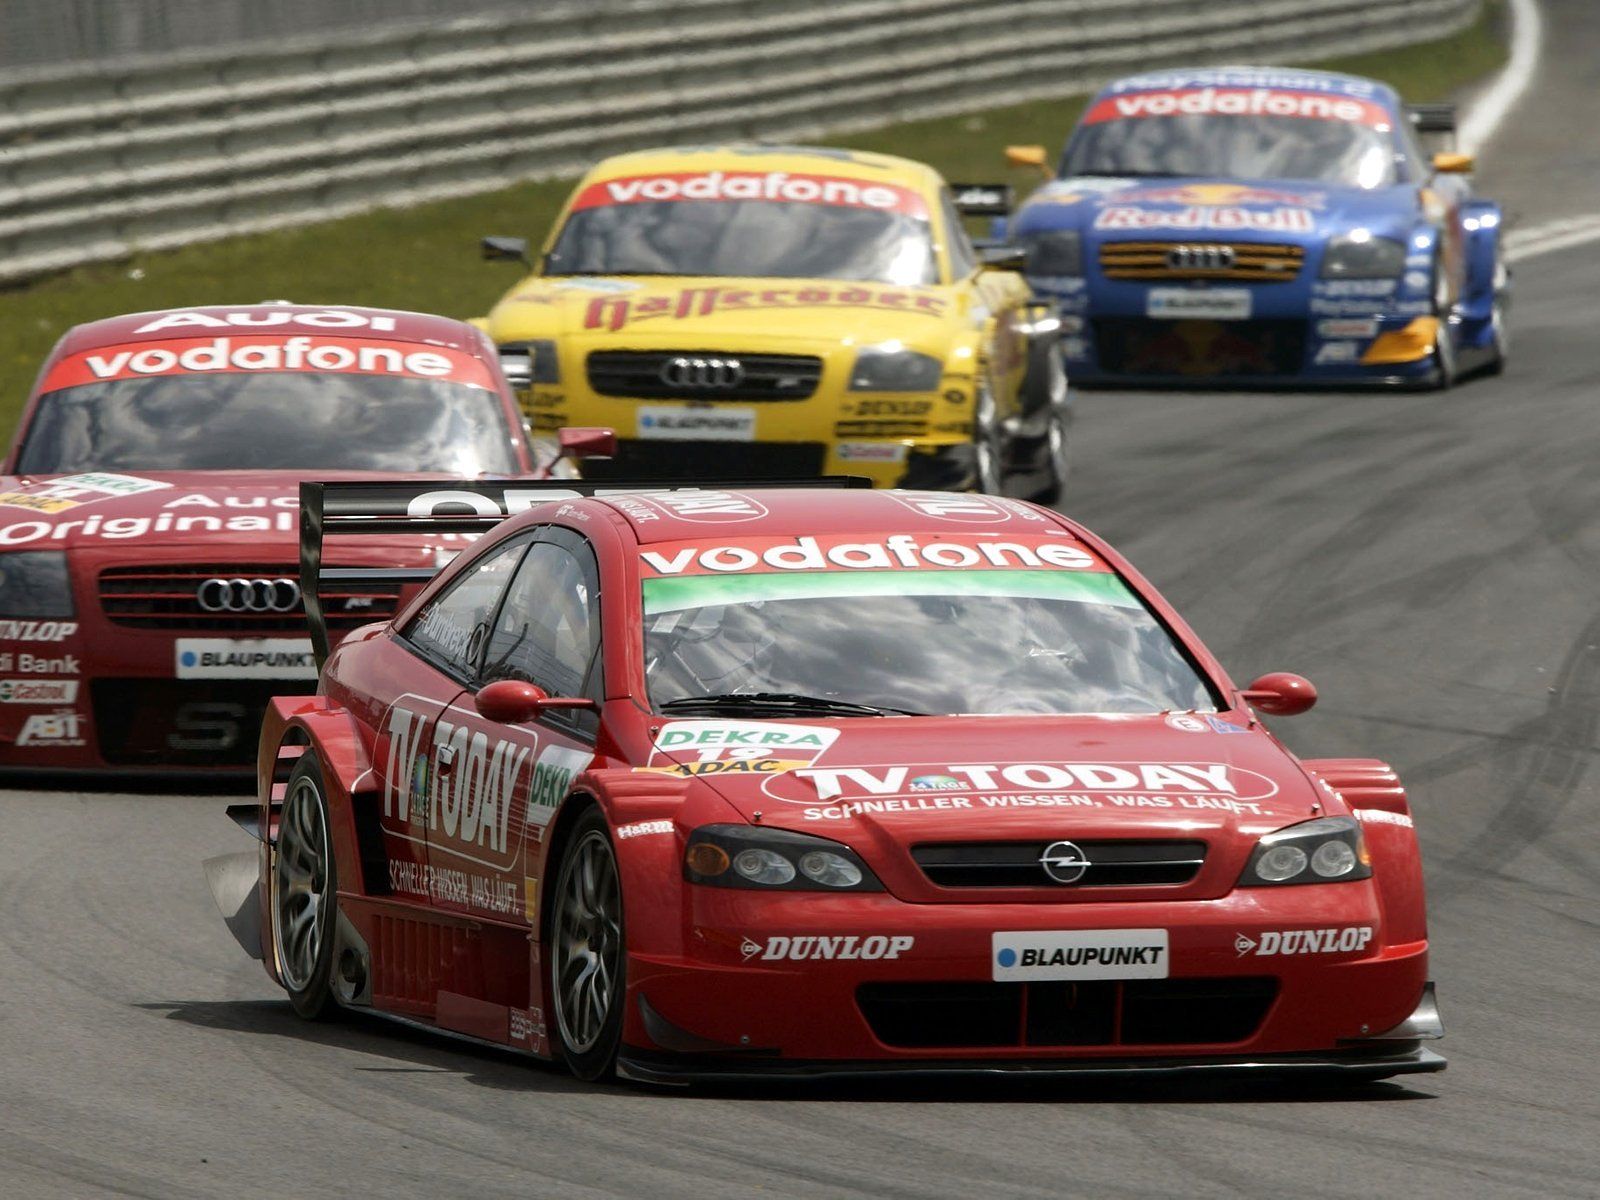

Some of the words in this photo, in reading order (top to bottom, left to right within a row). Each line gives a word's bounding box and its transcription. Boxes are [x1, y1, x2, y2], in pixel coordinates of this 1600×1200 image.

[1115, 88, 1366, 121] vodafone
[608, 171, 900, 208] vodafone
[1096, 207, 1199, 230] Red
[1211, 208, 1313, 232] Bull
[133, 311, 396, 333] Audi
[86, 338, 454, 379] vodafone
[0, 512, 292, 545] Original
[640, 534, 1094, 574] vodafone
[19, 654, 80, 673] Bank
[659, 730, 823, 747] DEKRA
[384, 707, 427, 822] TV
[430, 720, 531, 854] TODAY
[667, 760, 781, 777] ADAC
[795, 767, 910, 799] TV
[947, 764, 1238, 795] TODAY
[803, 797, 973, 820] SCHNELLER
[980, 796, 1103, 808] WISSEN,
[1113, 796, 1173, 807] WAS
[1182, 796, 1274, 816] LÄUFT.
[761, 935, 915, 961] DUNLOP
[1256, 927, 1373, 956] DUNLOP
[1021, 946, 1165, 967] BLAUPUNKT
